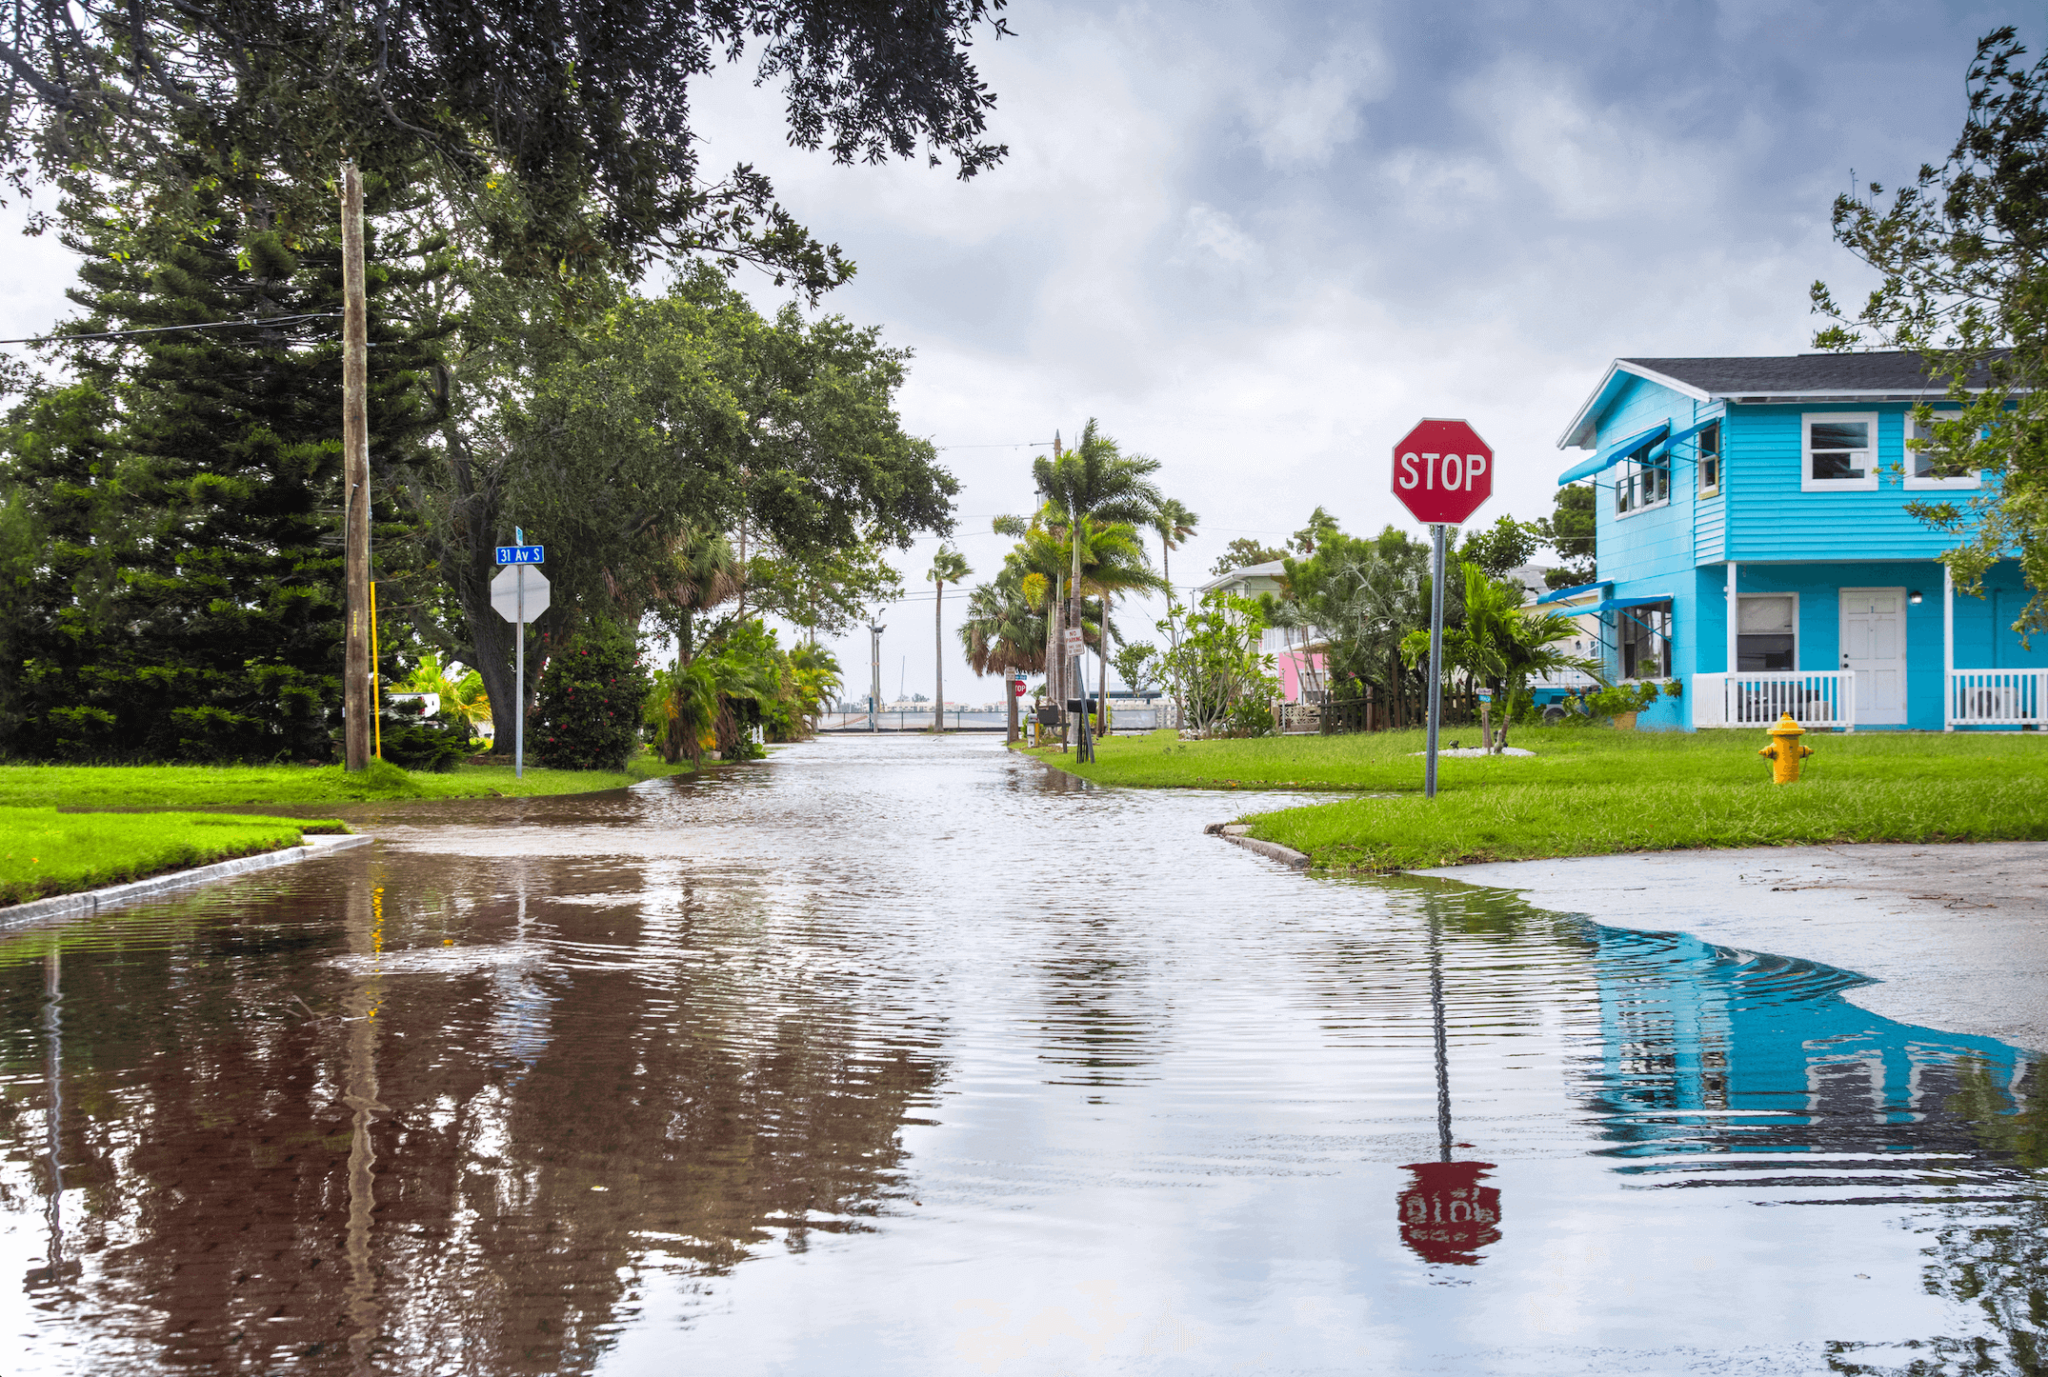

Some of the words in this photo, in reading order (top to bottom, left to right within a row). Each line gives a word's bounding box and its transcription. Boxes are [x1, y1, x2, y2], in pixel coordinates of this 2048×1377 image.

[1398, 452, 1487, 491] STOP
[500, 548, 511, 562] 31
[515, 548, 529, 561] Av
[533, 547, 540, 561] S
